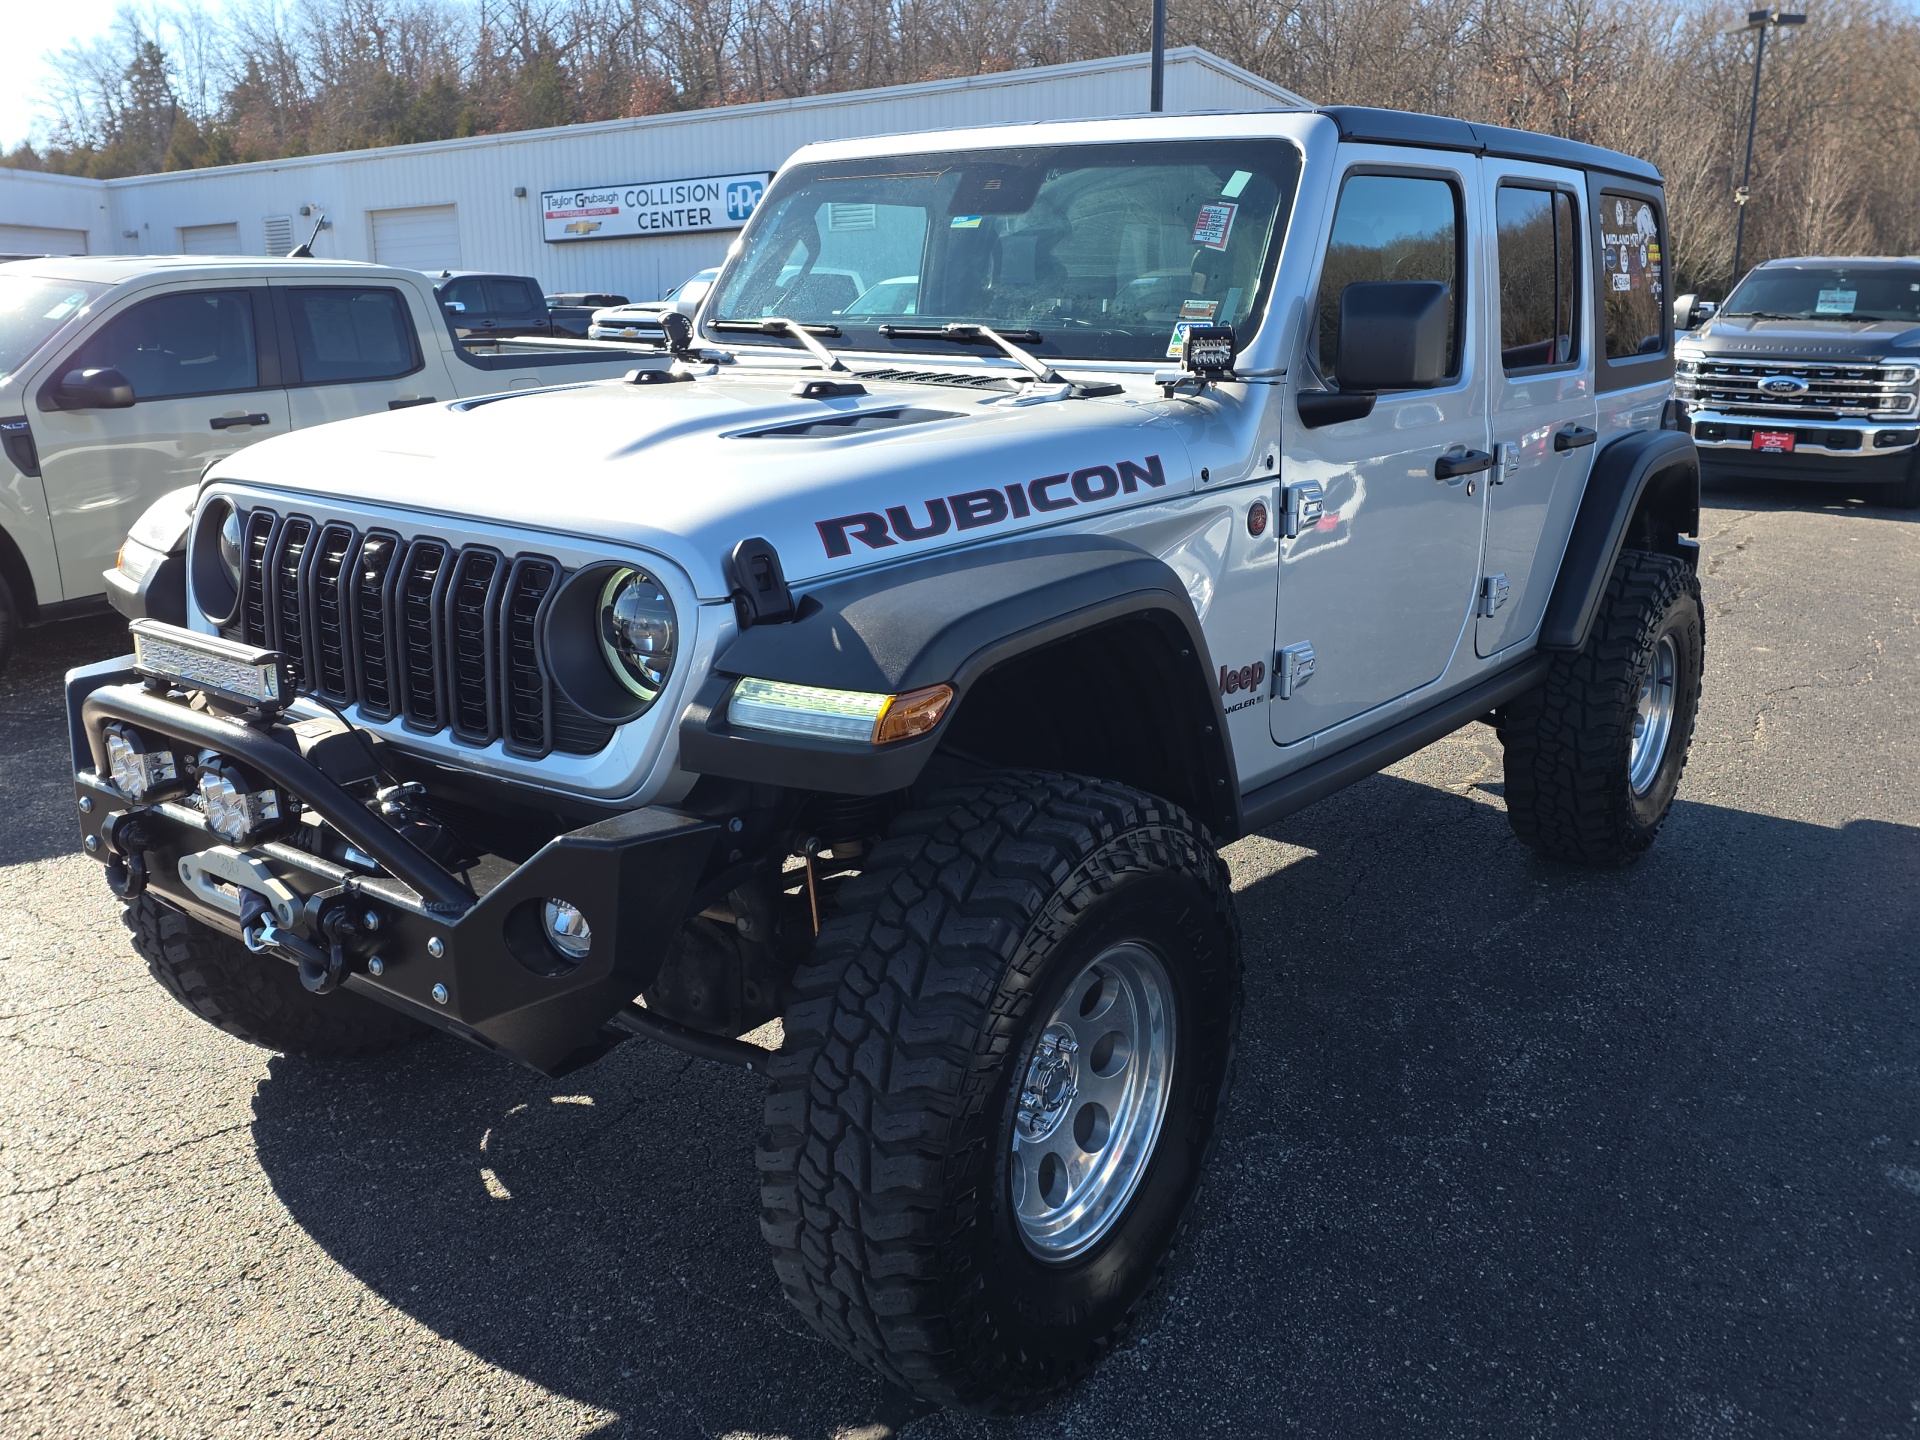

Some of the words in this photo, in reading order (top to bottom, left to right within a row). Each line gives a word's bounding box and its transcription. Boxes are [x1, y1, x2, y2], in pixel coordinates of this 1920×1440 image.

[544, 195, 573, 210] Taylor
[575, 191, 619, 208] Grubaugh
[625, 183, 719, 207] COLLISION
[637, 208, 712, 230] CENTER
[1770, 381, 1795, 391] Ford
[814, 454, 1167, 559] RUBICON
[1219, 660, 1266, 697] Jeep
